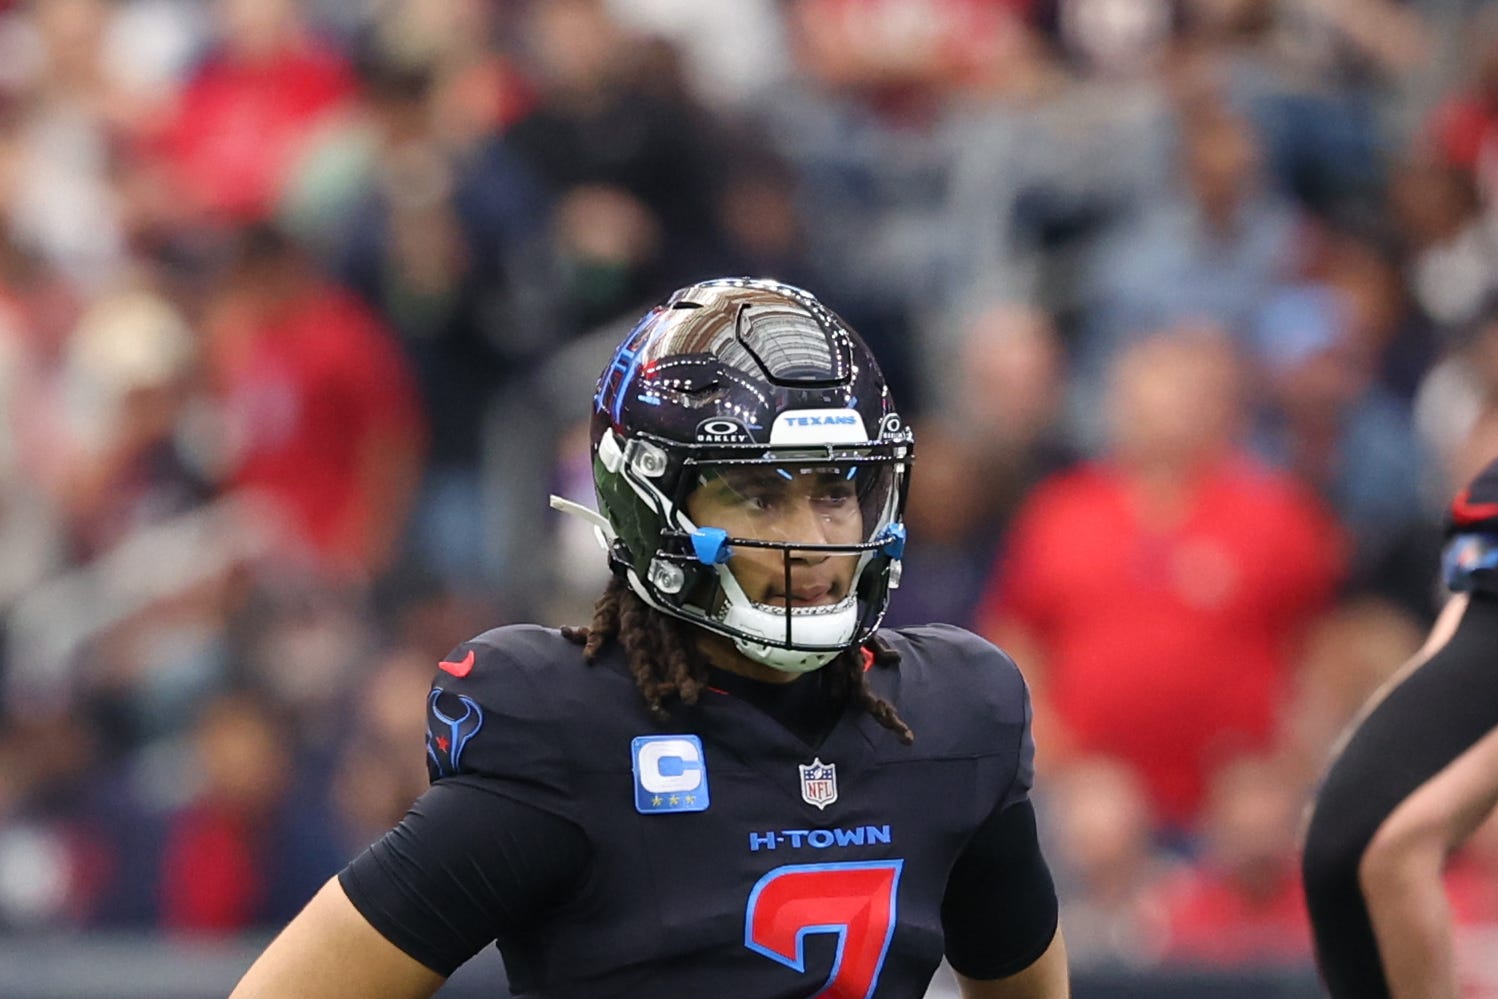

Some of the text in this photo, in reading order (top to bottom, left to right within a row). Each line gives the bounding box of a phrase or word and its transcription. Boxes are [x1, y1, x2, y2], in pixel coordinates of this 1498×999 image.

[784, 416, 856, 427] TEXANS
[697, 434, 747, 443] OAKLEY
[638, 740, 702, 793] C
[808, 780, 832, 799] NFL
[750, 825, 891, 851] H-TOWN
